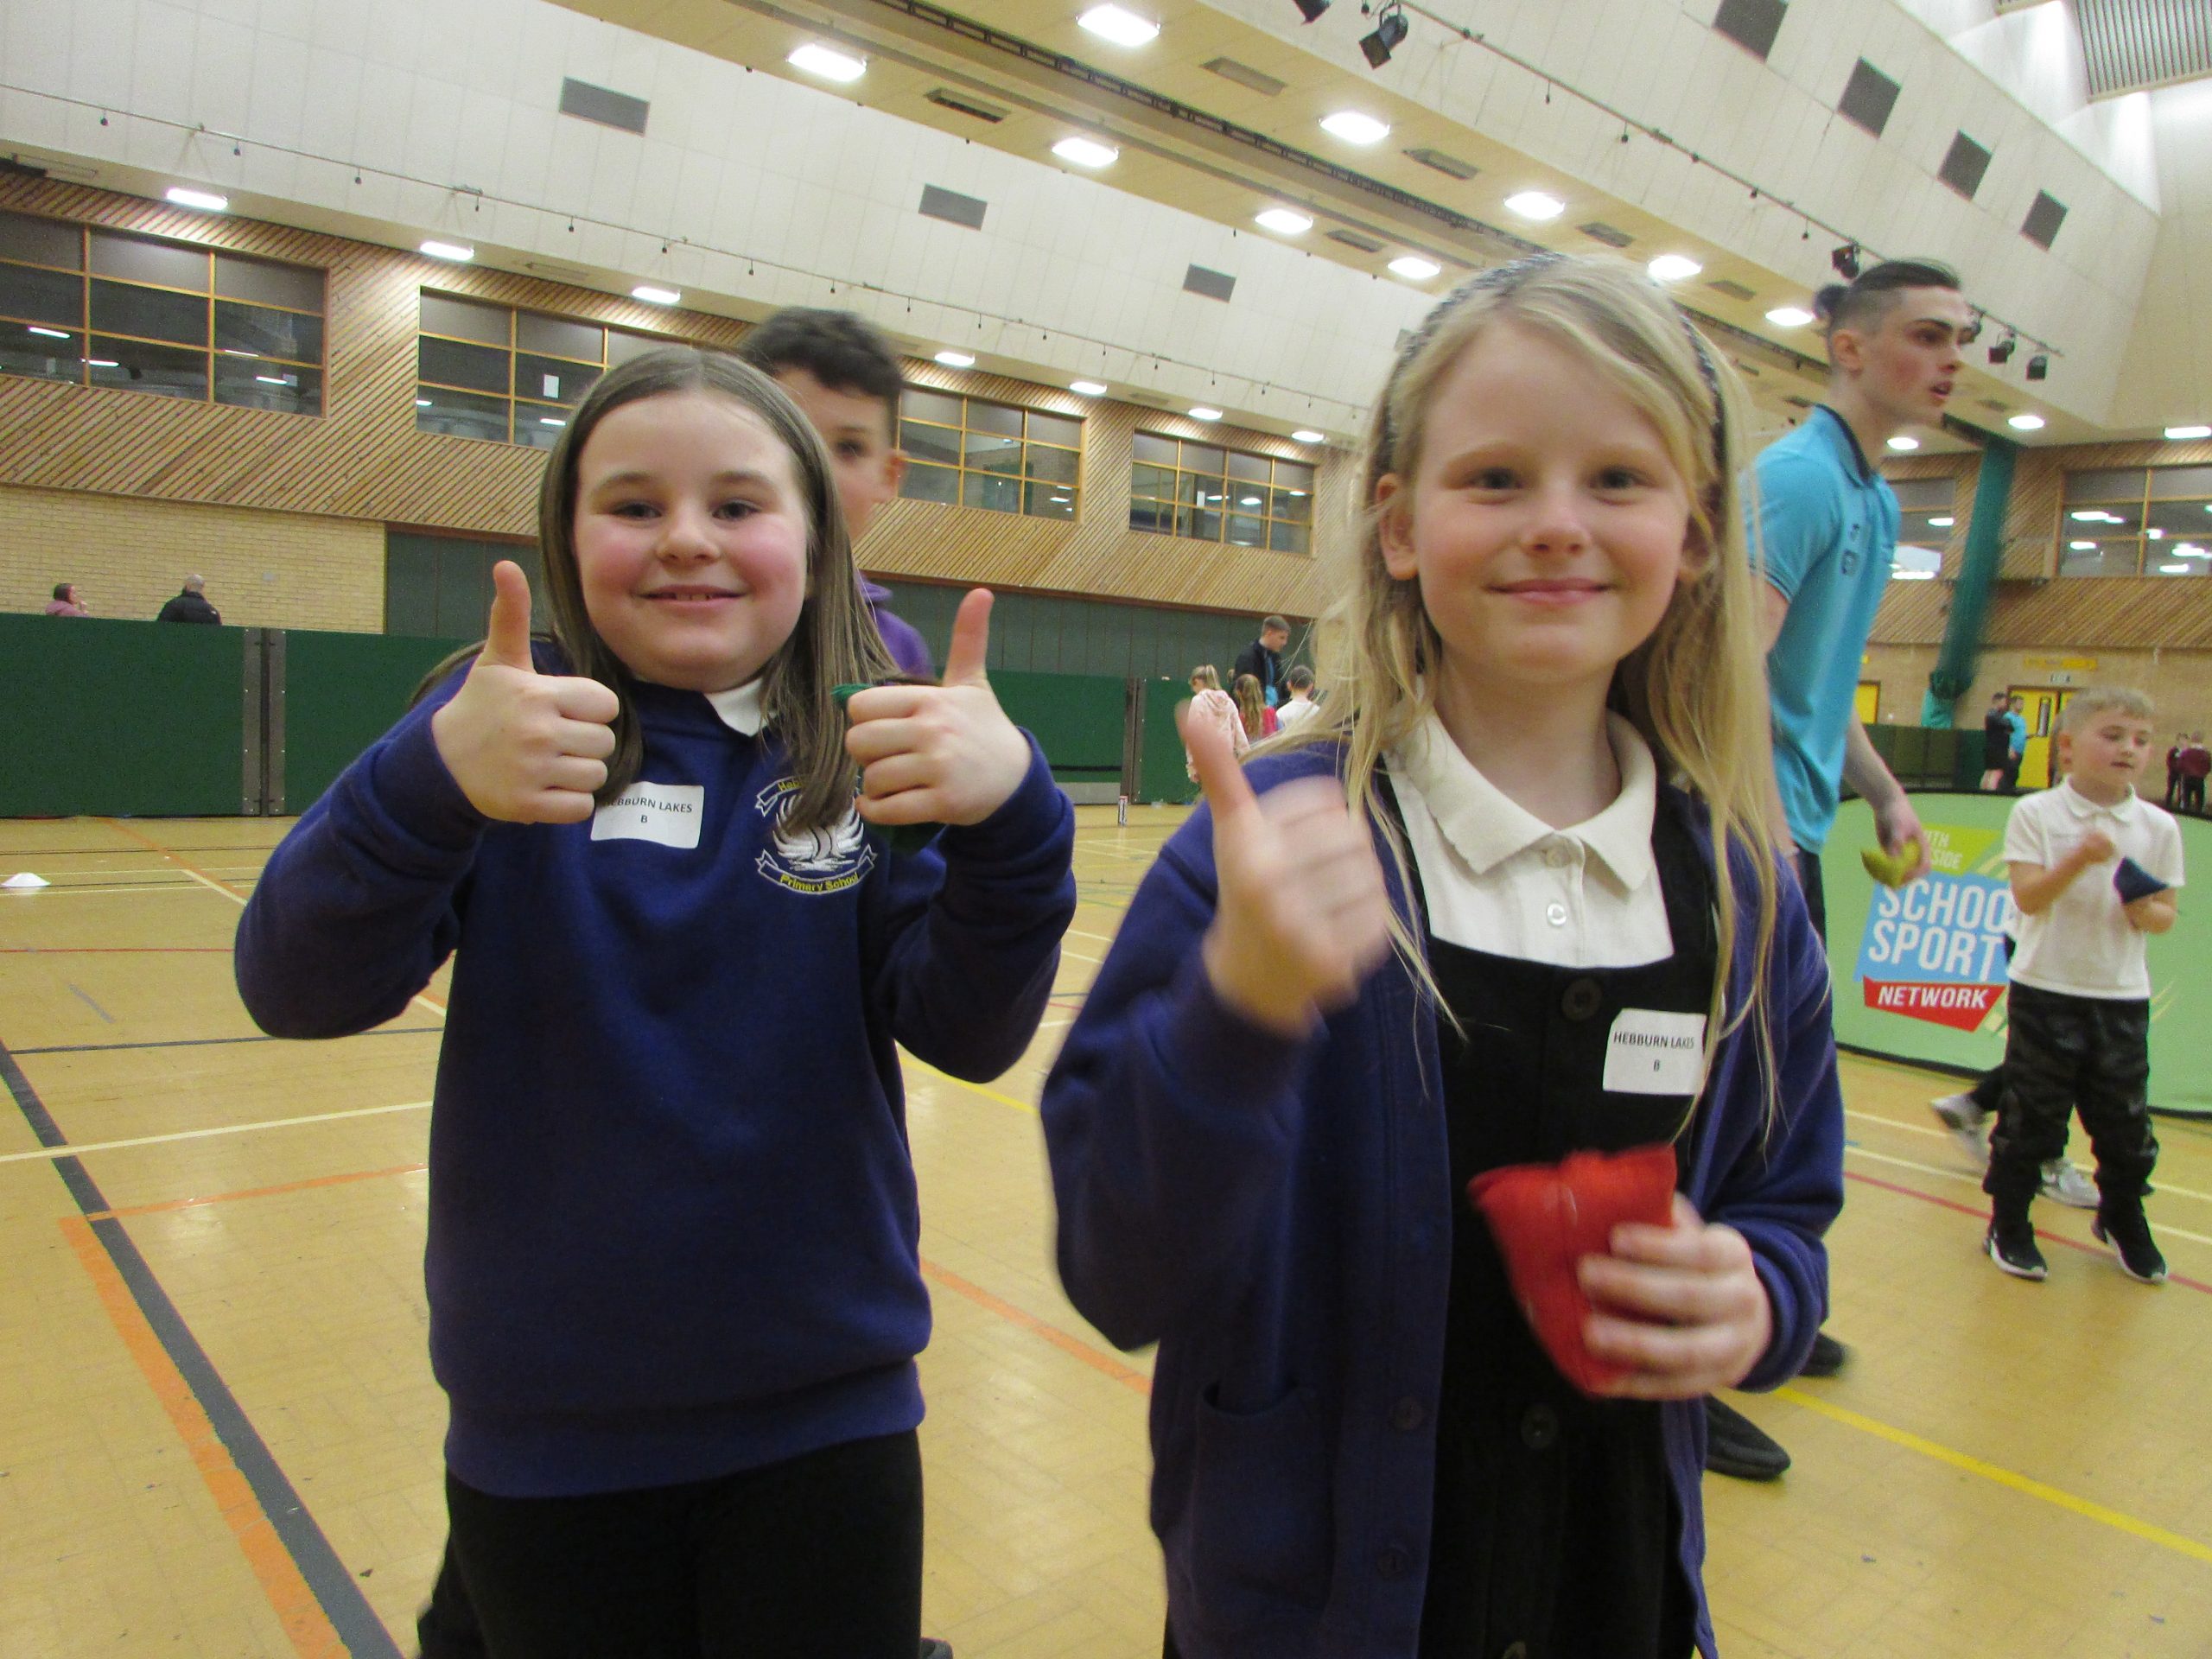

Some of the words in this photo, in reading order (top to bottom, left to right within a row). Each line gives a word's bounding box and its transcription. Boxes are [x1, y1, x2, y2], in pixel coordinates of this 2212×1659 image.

[658, 801, 693, 813] LAKES
[640, 815, 648, 823] B
[779, 873, 823, 892] Primary
[825, 870, 859, 890] School
[1878, 879, 2010, 933] SCHOO
[1868, 919, 2005, 982] SPORT
[1877, 985, 1990, 1009] NETWORK
[1612, 1031, 1669, 1048] HEBBURN
[1670, 1037, 1694, 1049] LAKES
